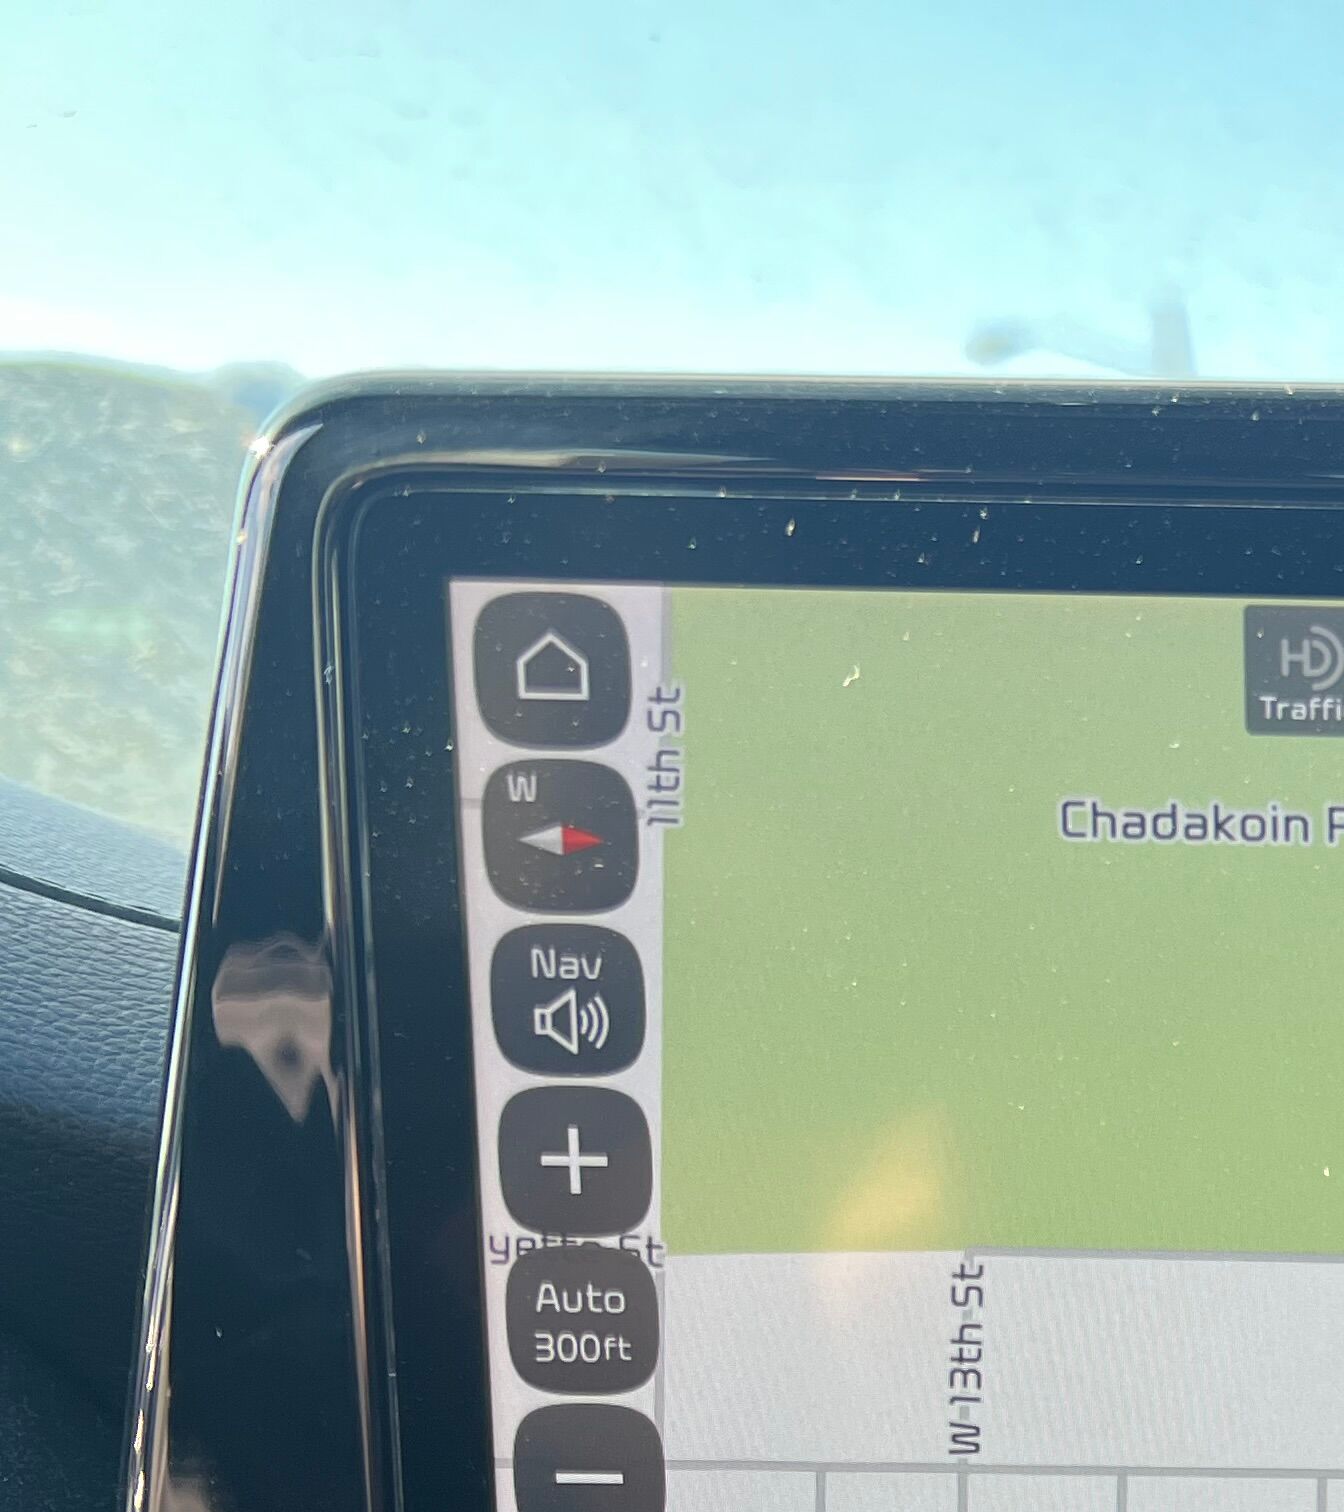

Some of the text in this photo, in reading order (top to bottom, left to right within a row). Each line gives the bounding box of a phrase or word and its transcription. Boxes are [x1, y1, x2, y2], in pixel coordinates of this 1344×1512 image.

[646, 686, 682, 827] 11th St
[507, 772, 538, 801] W
[1061, 801, 1310, 843] Chadakoin
[531, 948, 603, 980] Nav
[536, 1282, 626, 1314] Auto
[534, 1331, 632, 1363] 300ft
[950, 1262, 985, 1456] W 13th St
